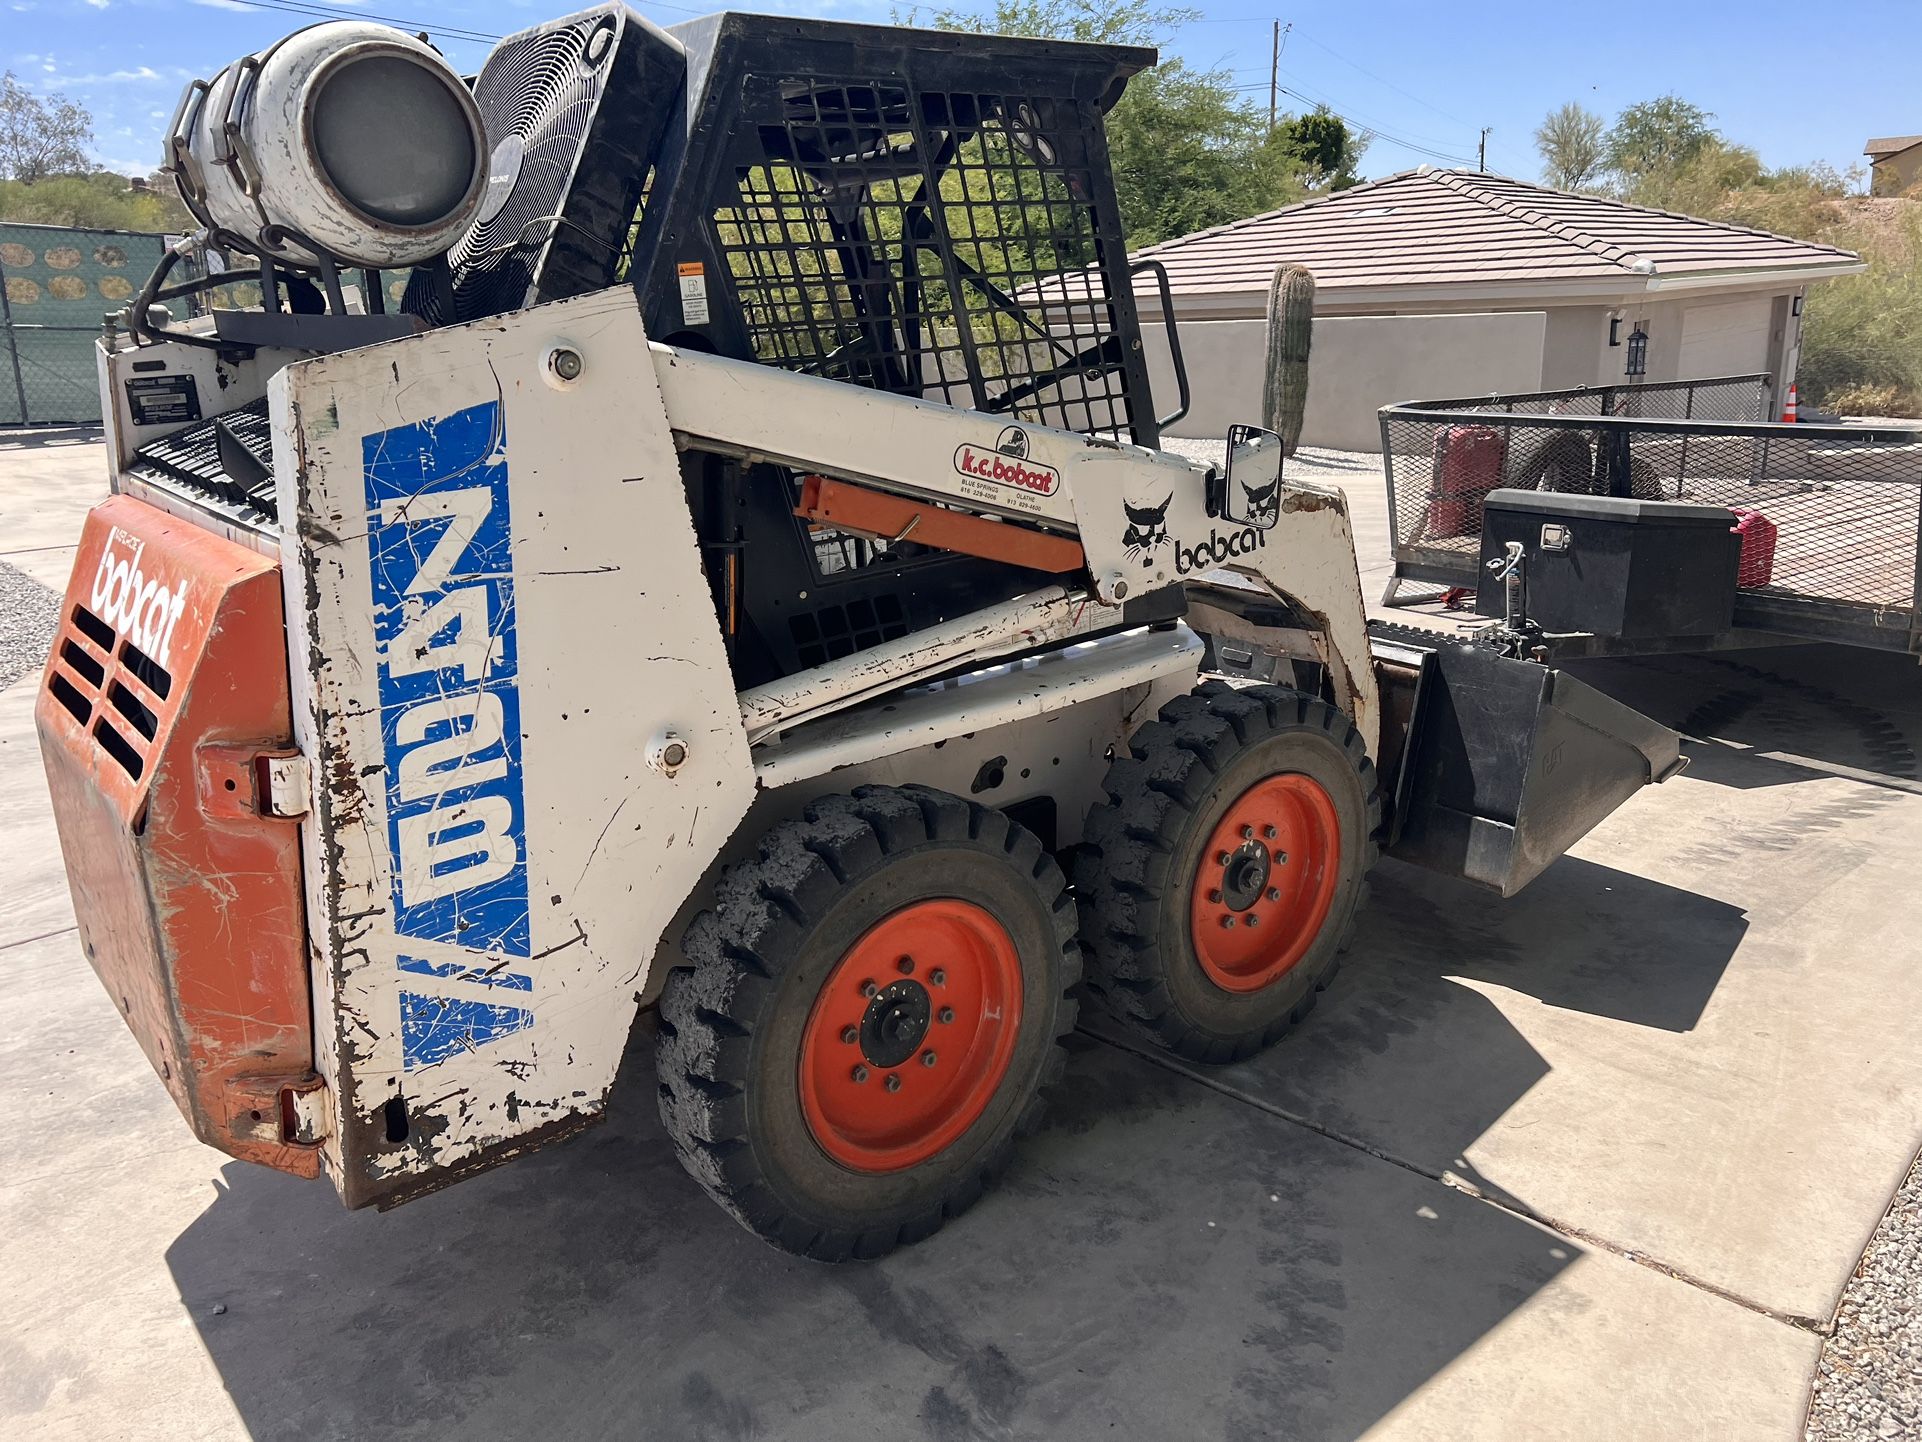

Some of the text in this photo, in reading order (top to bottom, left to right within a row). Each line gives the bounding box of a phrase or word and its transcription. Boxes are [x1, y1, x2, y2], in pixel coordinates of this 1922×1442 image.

[961, 478, 999, 493] BLUE SPRINGS
[1174, 527, 1266, 575] bobcat
[91, 525, 188, 669] bobcat
